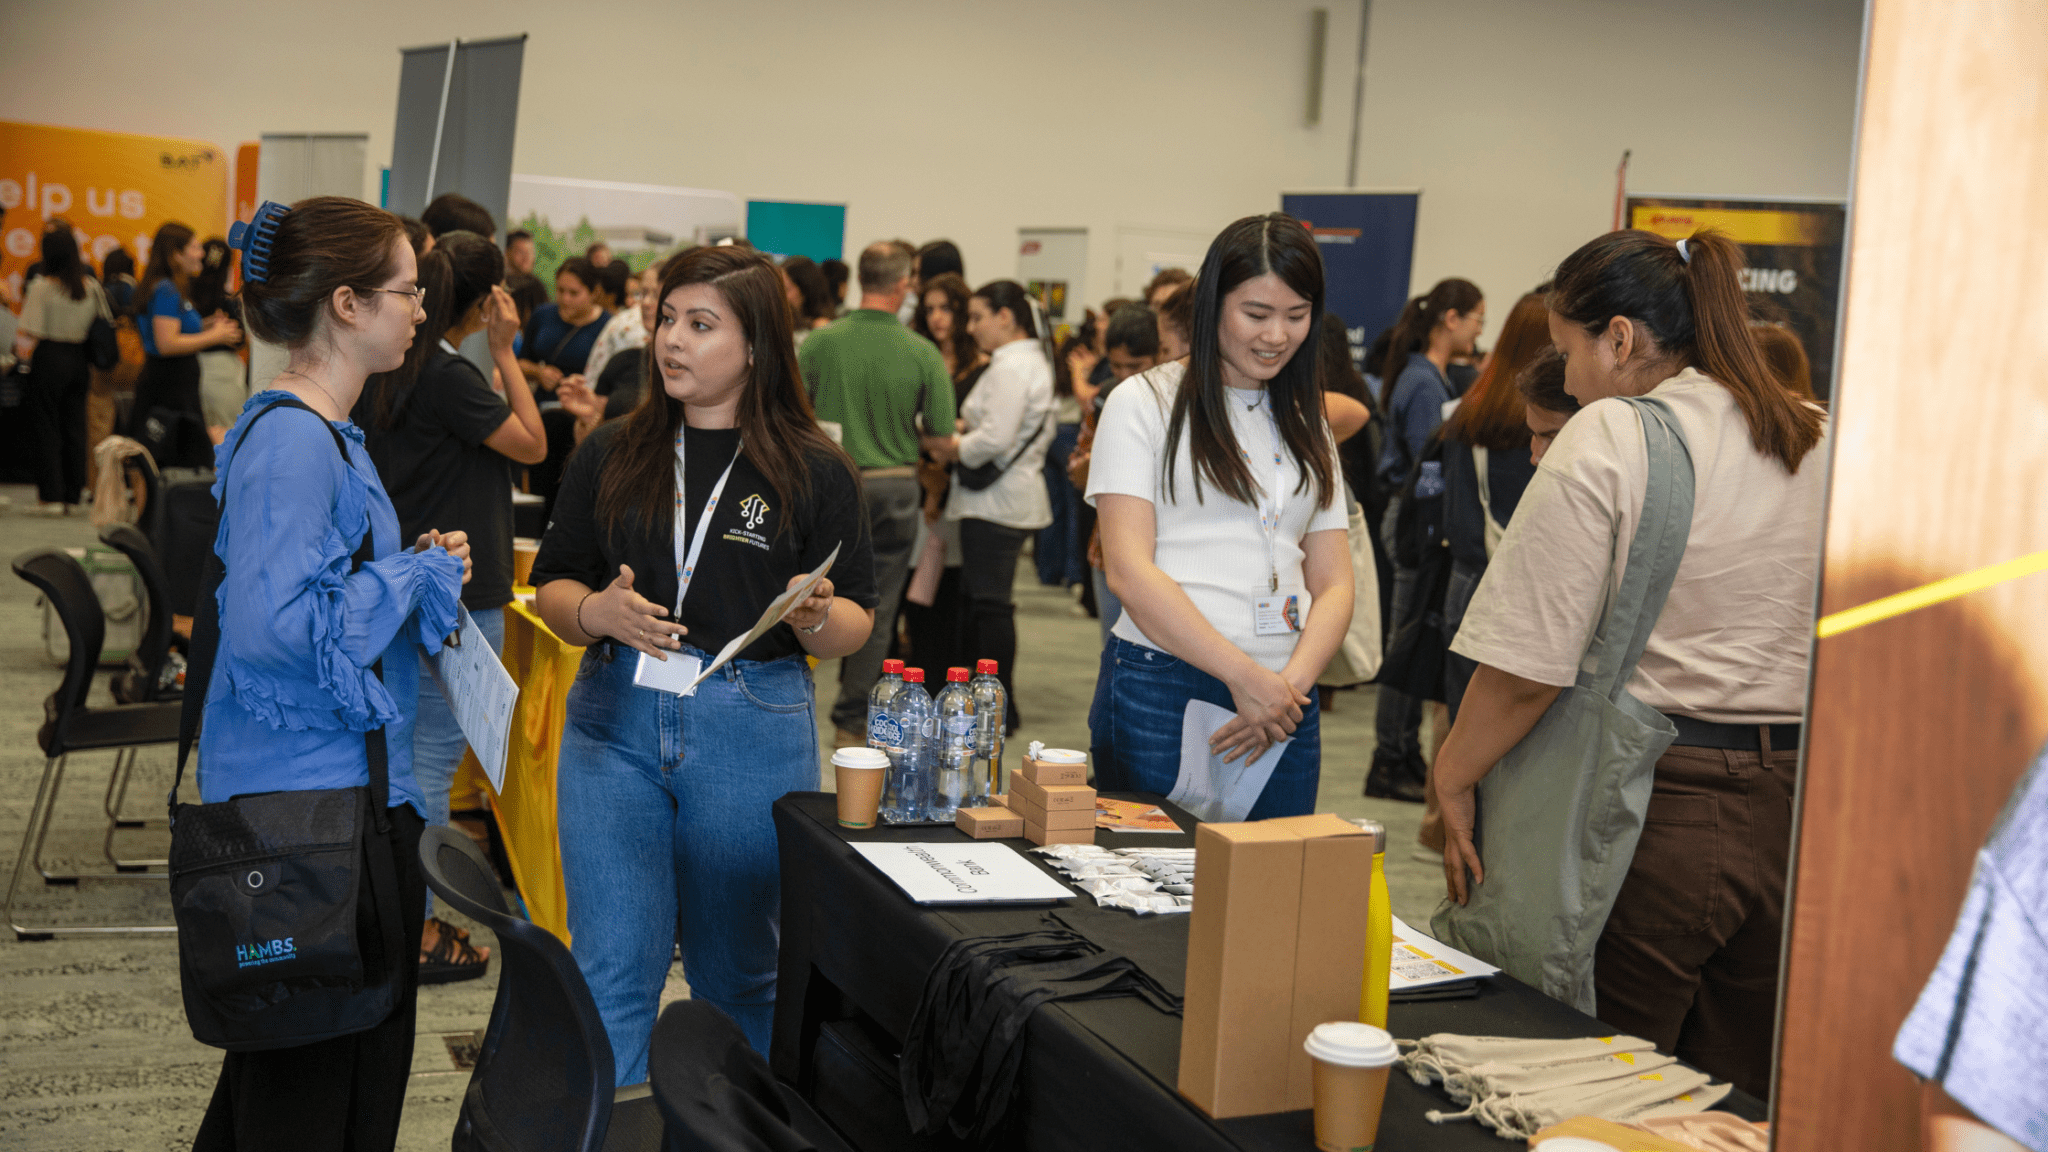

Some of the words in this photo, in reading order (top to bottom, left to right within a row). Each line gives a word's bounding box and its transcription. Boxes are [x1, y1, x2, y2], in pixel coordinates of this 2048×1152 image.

[86, 186, 145, 219] us
[723, 533, 750, 544] BRIGHTER
[749, 538, 770, 551] FUTURES
[729, 528, 766, 542] KICK-STARTING
[903, 845, 978, 893] Commonwealth
[956, 859, 991, 875] Bank
[236, 937, 297, 961] HAMBS.
